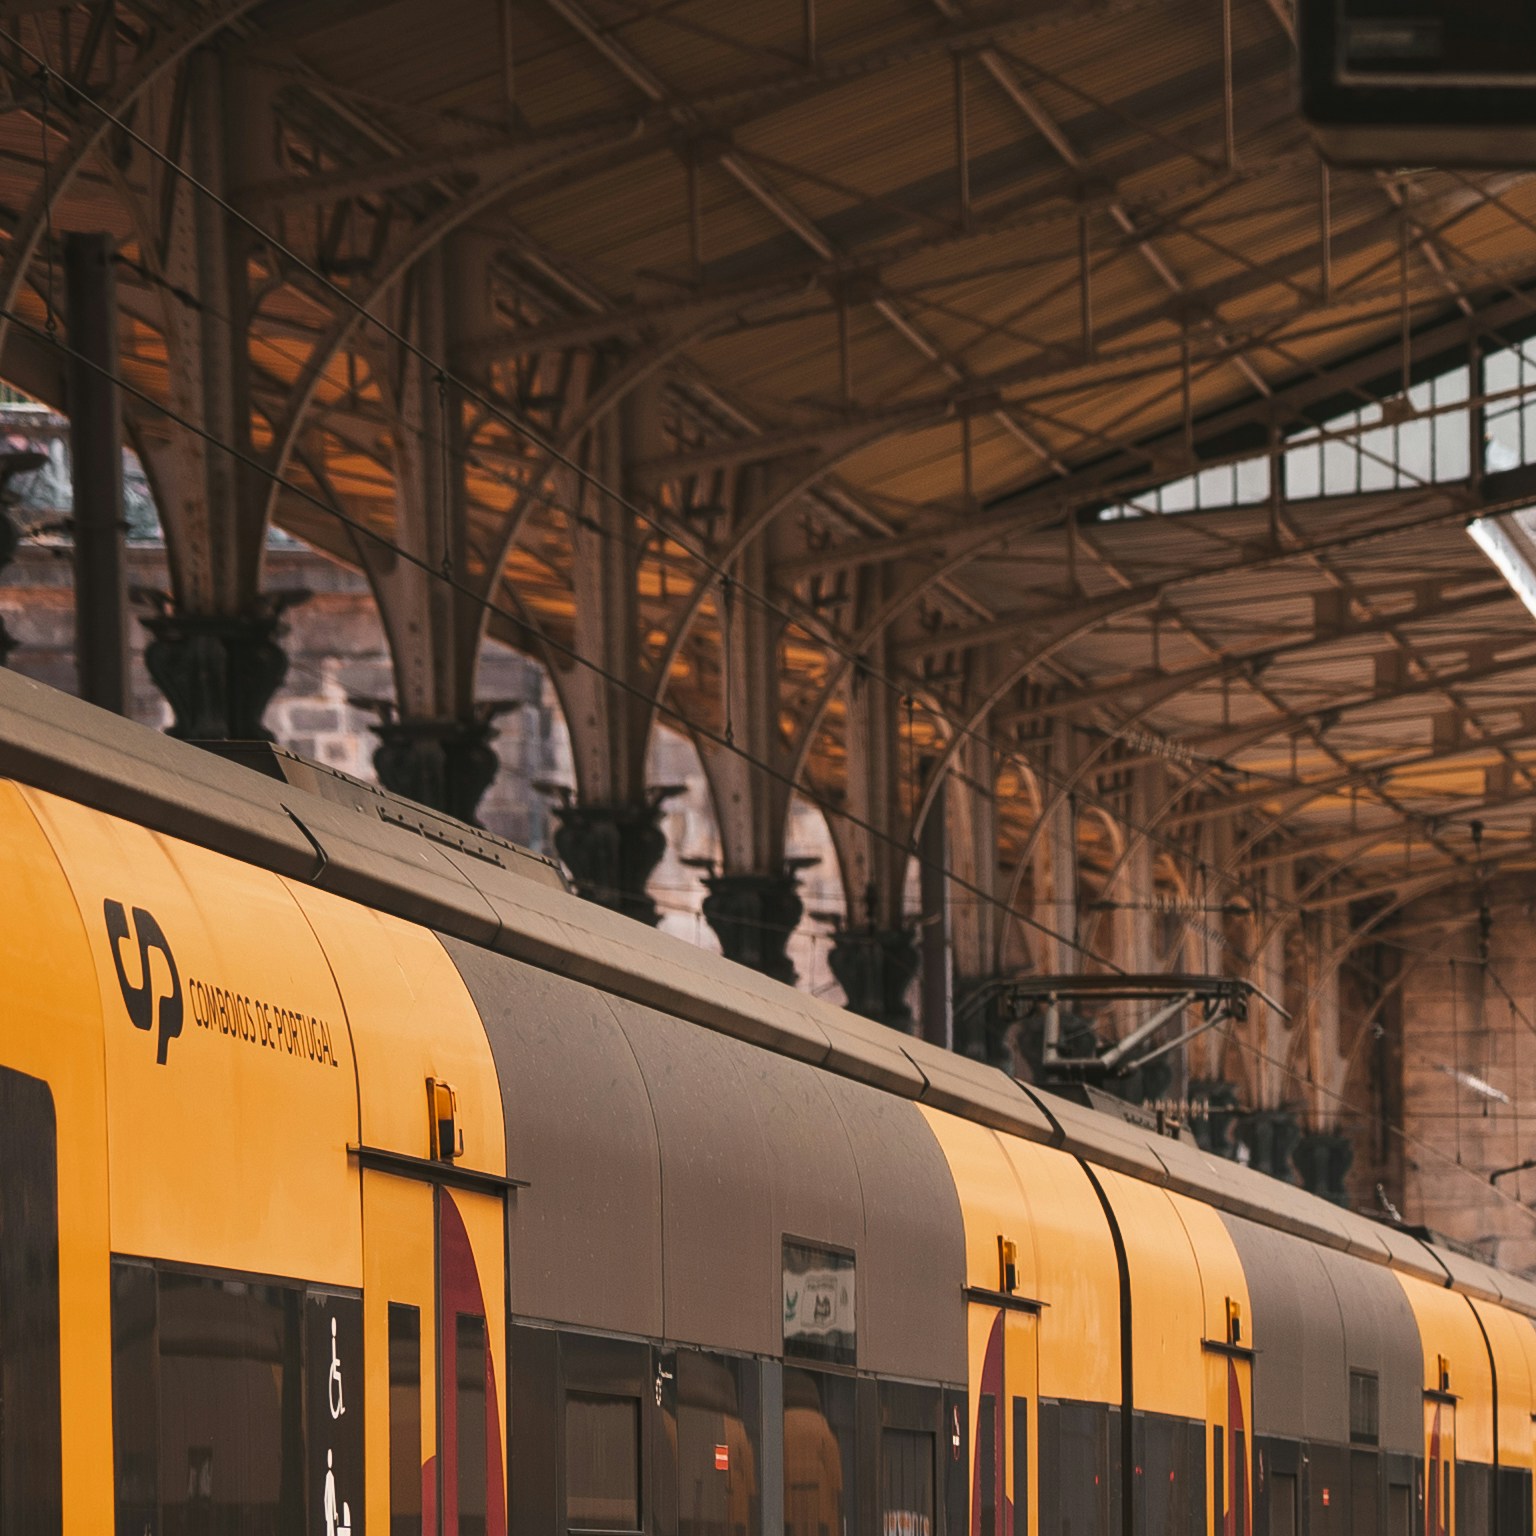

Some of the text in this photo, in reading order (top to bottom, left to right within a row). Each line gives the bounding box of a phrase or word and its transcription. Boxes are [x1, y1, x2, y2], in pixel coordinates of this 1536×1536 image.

[189, 978, 338, 1067] COMBOIOS DE PORTUGAL
